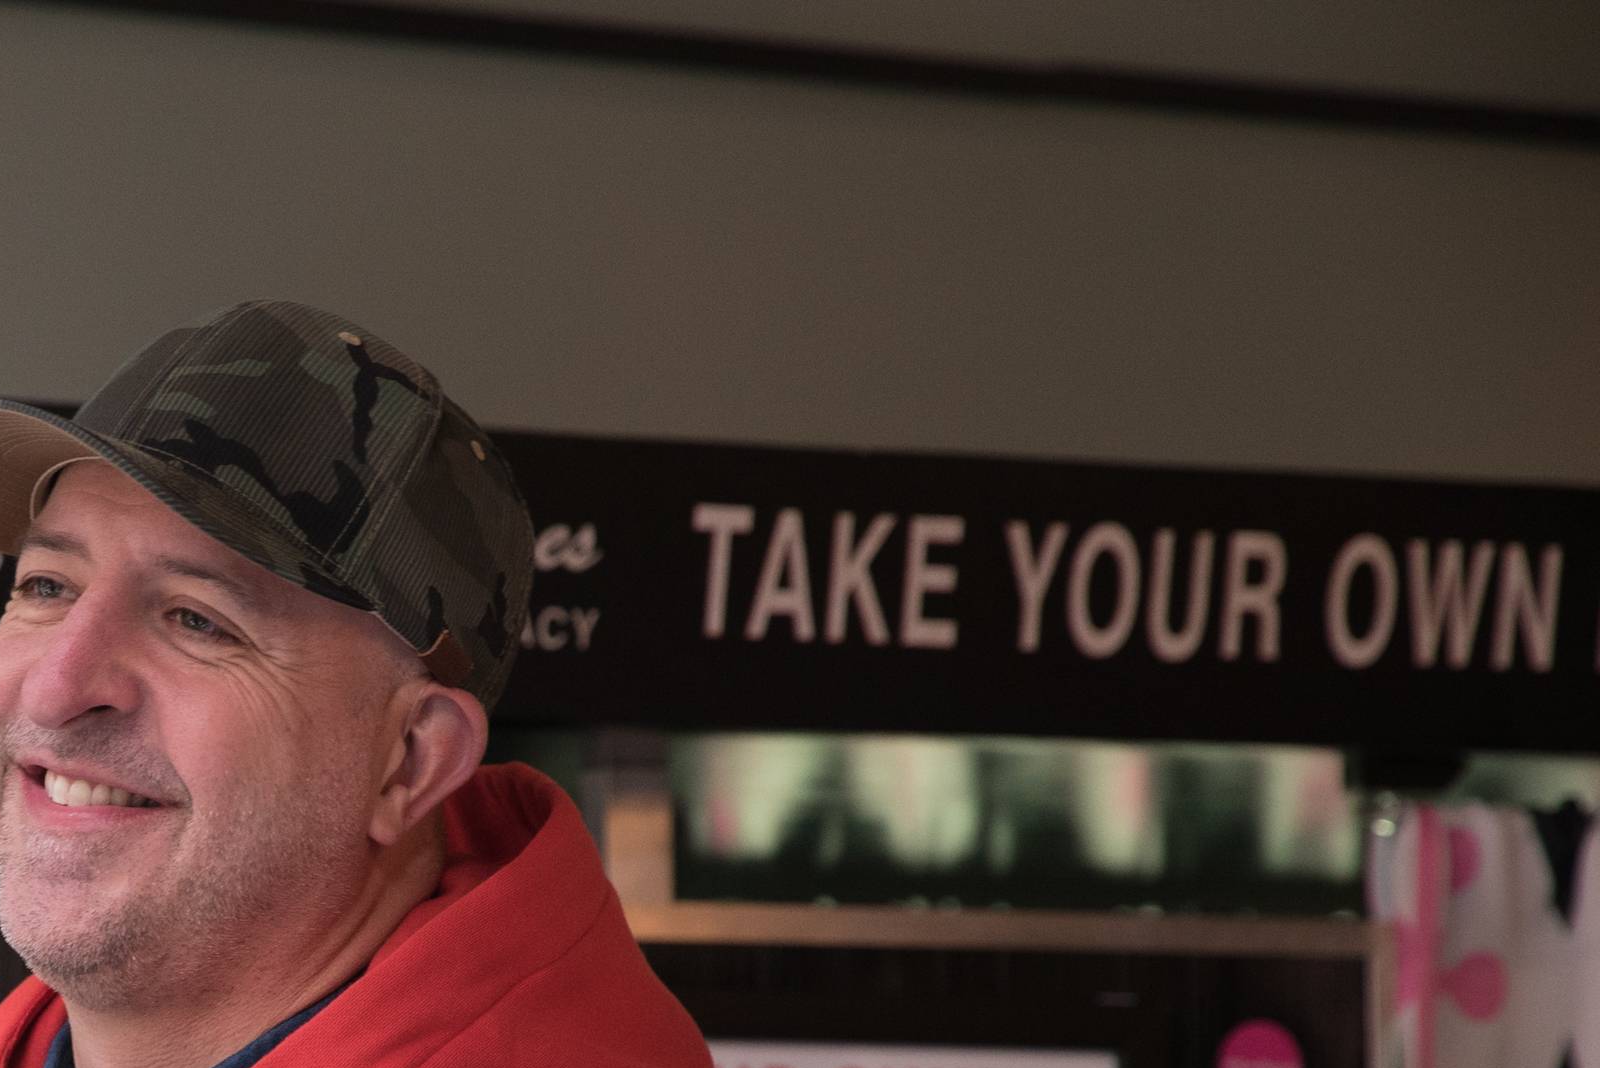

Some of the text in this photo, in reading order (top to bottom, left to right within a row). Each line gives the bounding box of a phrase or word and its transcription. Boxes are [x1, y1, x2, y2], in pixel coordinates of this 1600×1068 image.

[691, 502, 967, 649] TAKE
[1007, 520, 1289, 664] YOUR
[1324, 532, 1564, 672] OWN
